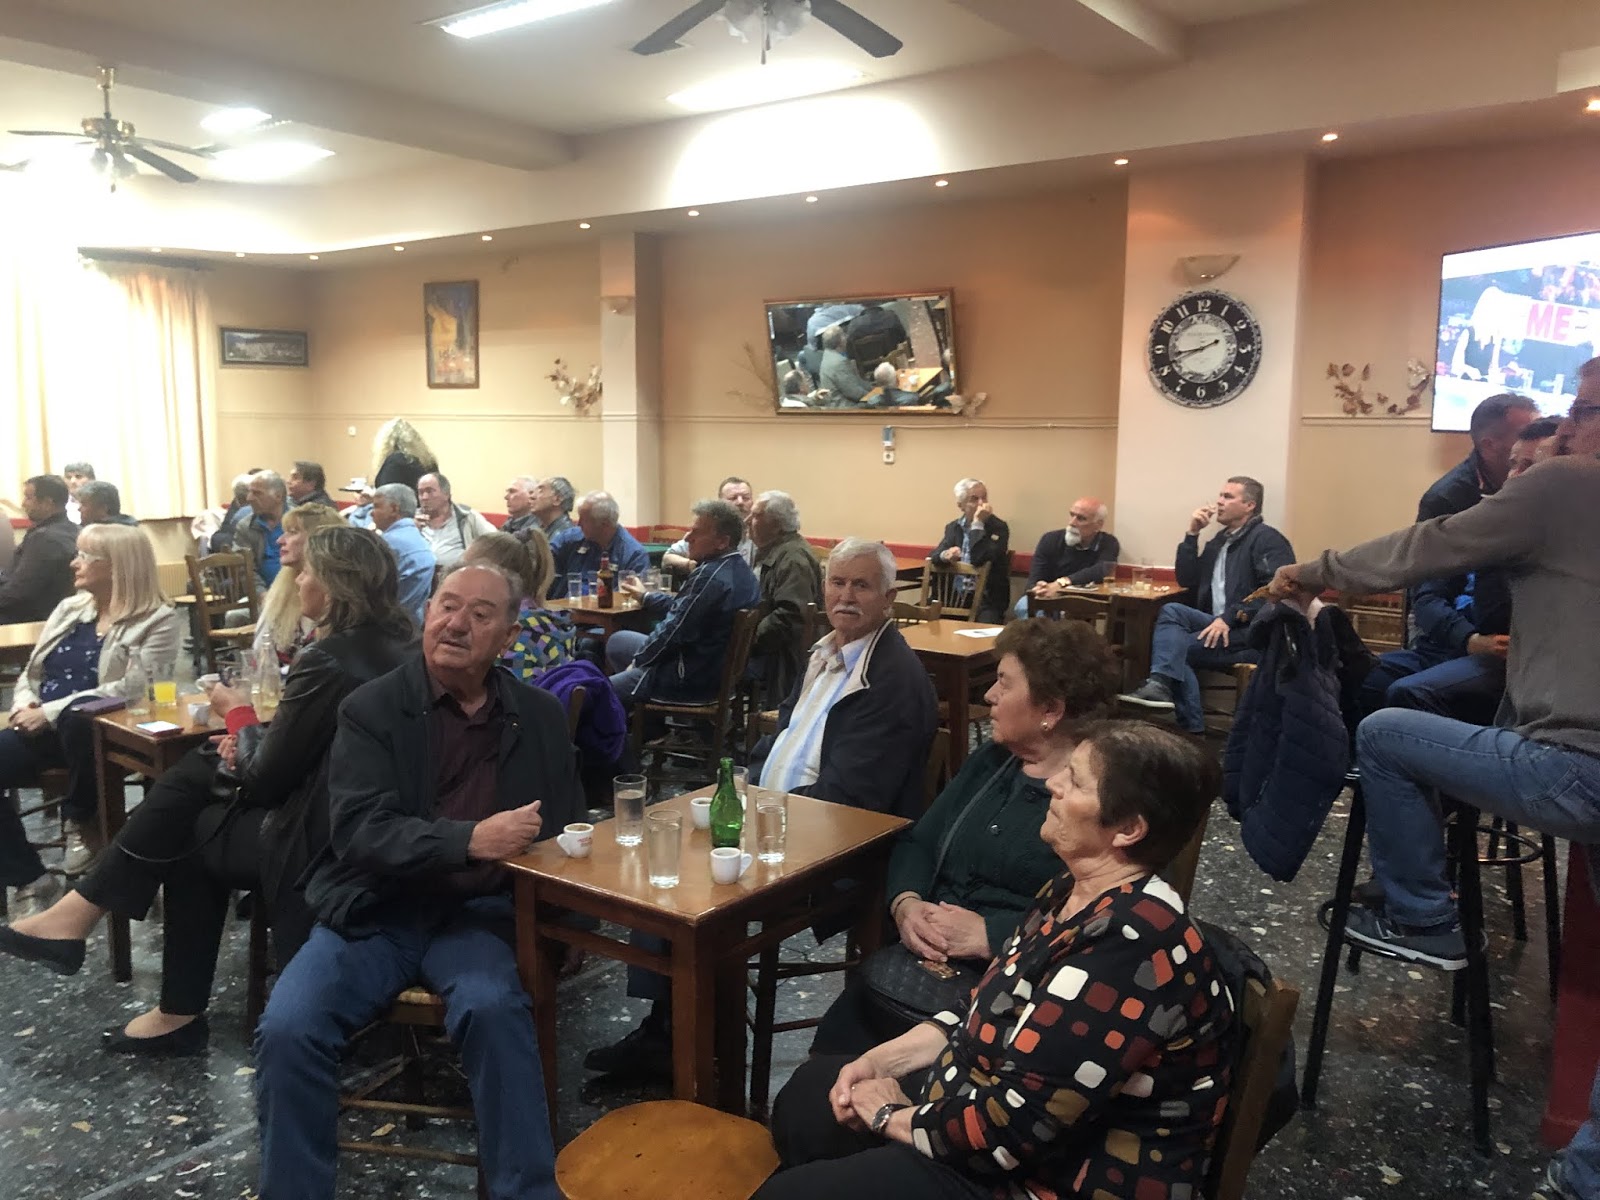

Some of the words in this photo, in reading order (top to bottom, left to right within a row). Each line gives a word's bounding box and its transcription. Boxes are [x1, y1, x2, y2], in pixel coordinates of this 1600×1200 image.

[1197, 299, 1212, 312] 12
[1160, 320, 1175, 334] 10
[1196, 386, 1206, 398] 6
